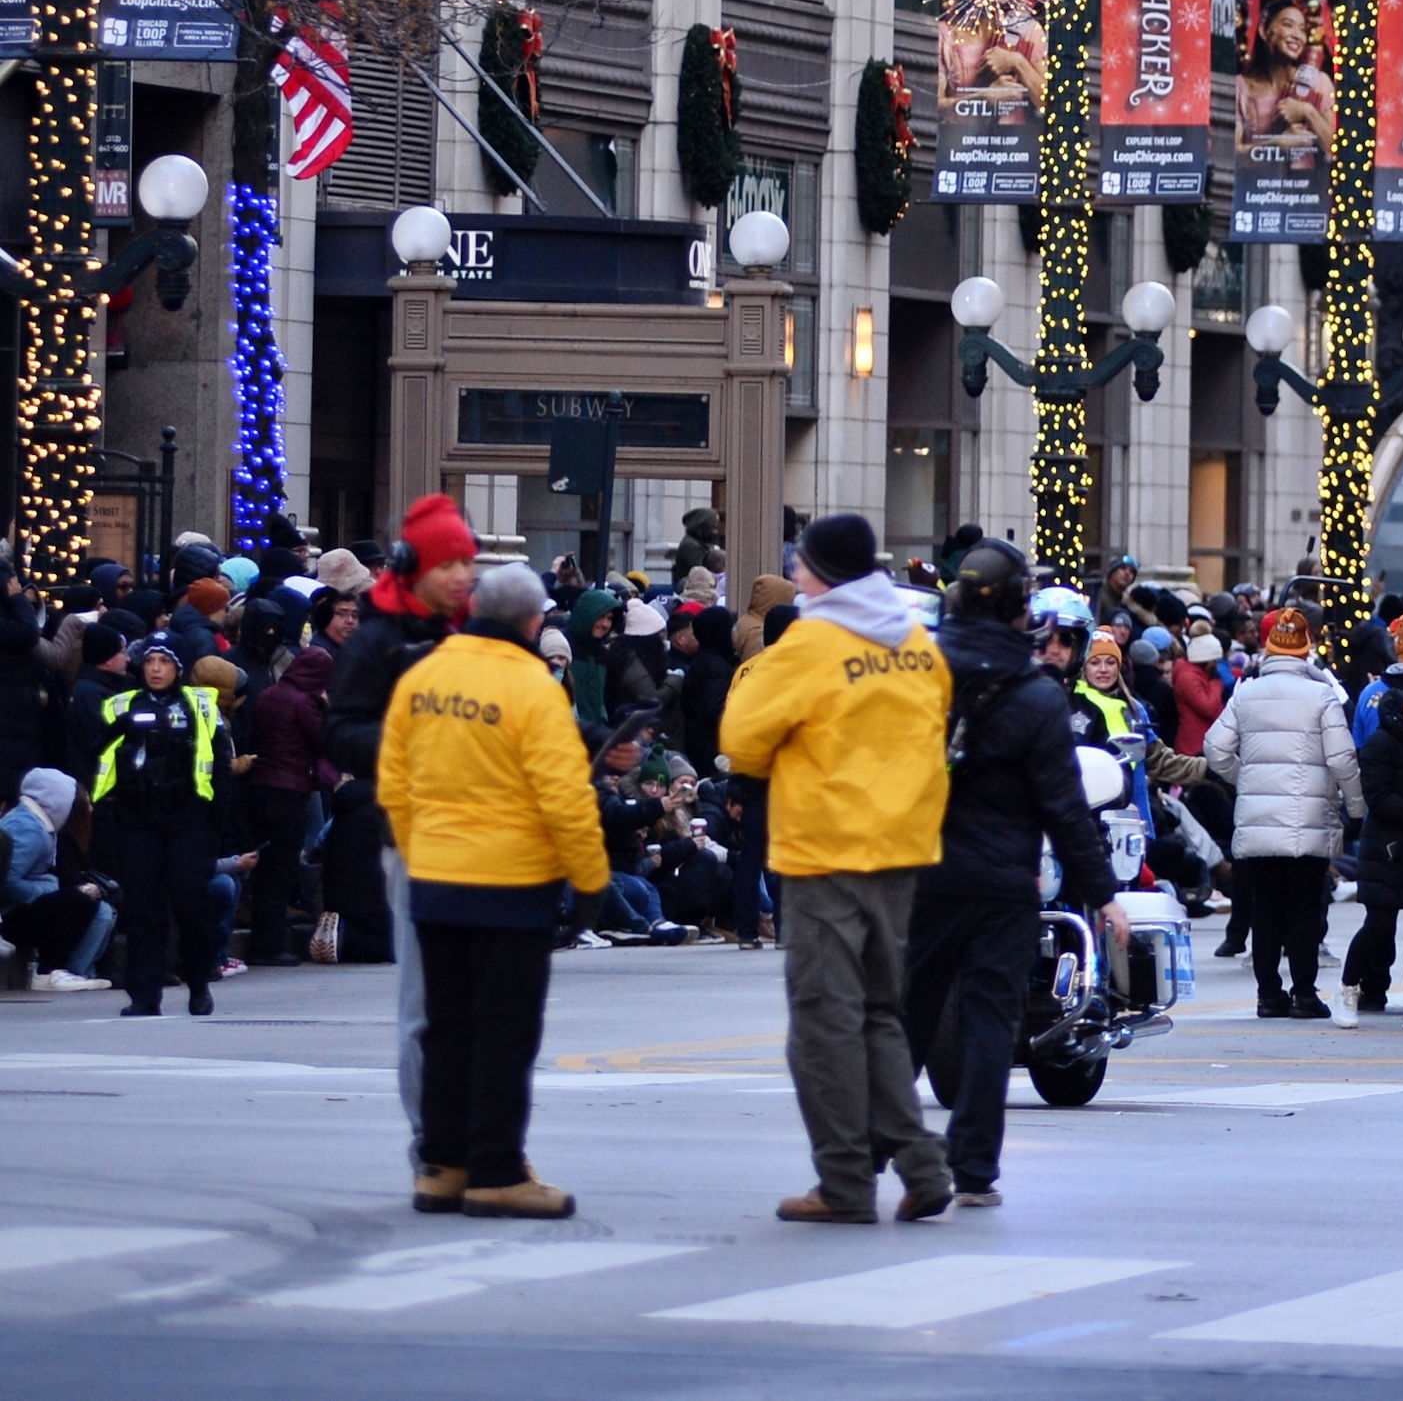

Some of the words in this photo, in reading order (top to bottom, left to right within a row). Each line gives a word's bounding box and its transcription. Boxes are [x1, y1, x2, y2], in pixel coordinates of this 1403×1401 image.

[137, 20, 168, 28] CHICAGO
[136, 28, 167, 39] LOOP
[955, 99, 992, 116] GTL
[950, 149, 1030, 164] LoopChicago.com
[1113, 149, 1193, 166] LoopChicago.com
[1251, 146, 1285, 161] GTL
[963, 178, 987, 188] LOOP
[1127, 179, 1151, 188] LOOP
[98, 181, 128, 204] MR
[451, 269, 493, 280] STATE
[536, 395, 634, 418] SUBWY
[843, 649, 919, 684] pluto
[411, 687, 480, 720] pluto
